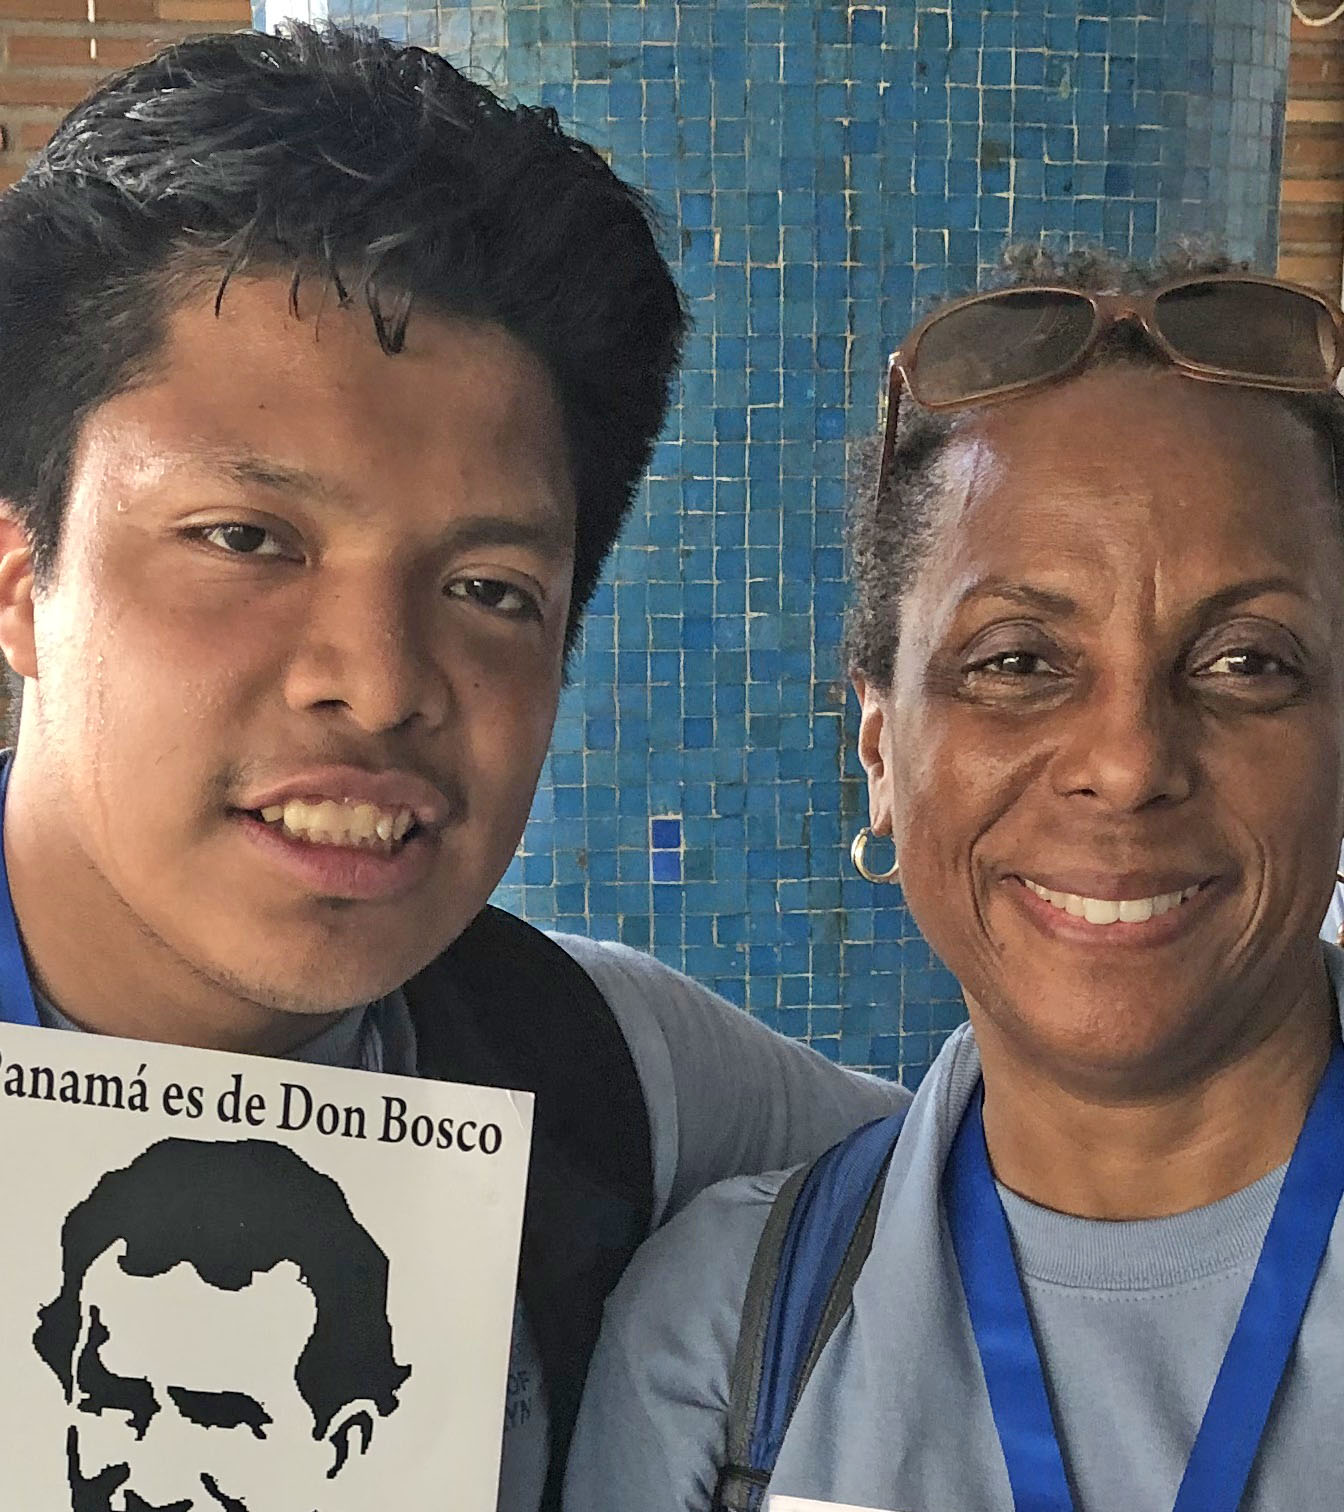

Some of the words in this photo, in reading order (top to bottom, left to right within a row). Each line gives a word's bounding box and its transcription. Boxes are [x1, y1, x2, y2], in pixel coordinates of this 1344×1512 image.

[161, 1080, 204, 1119] es
[217, 1073, 266, 1126] de
[276, 1081, 367, 1140] Don
[376, 1095, 503, 1155] Bosco
